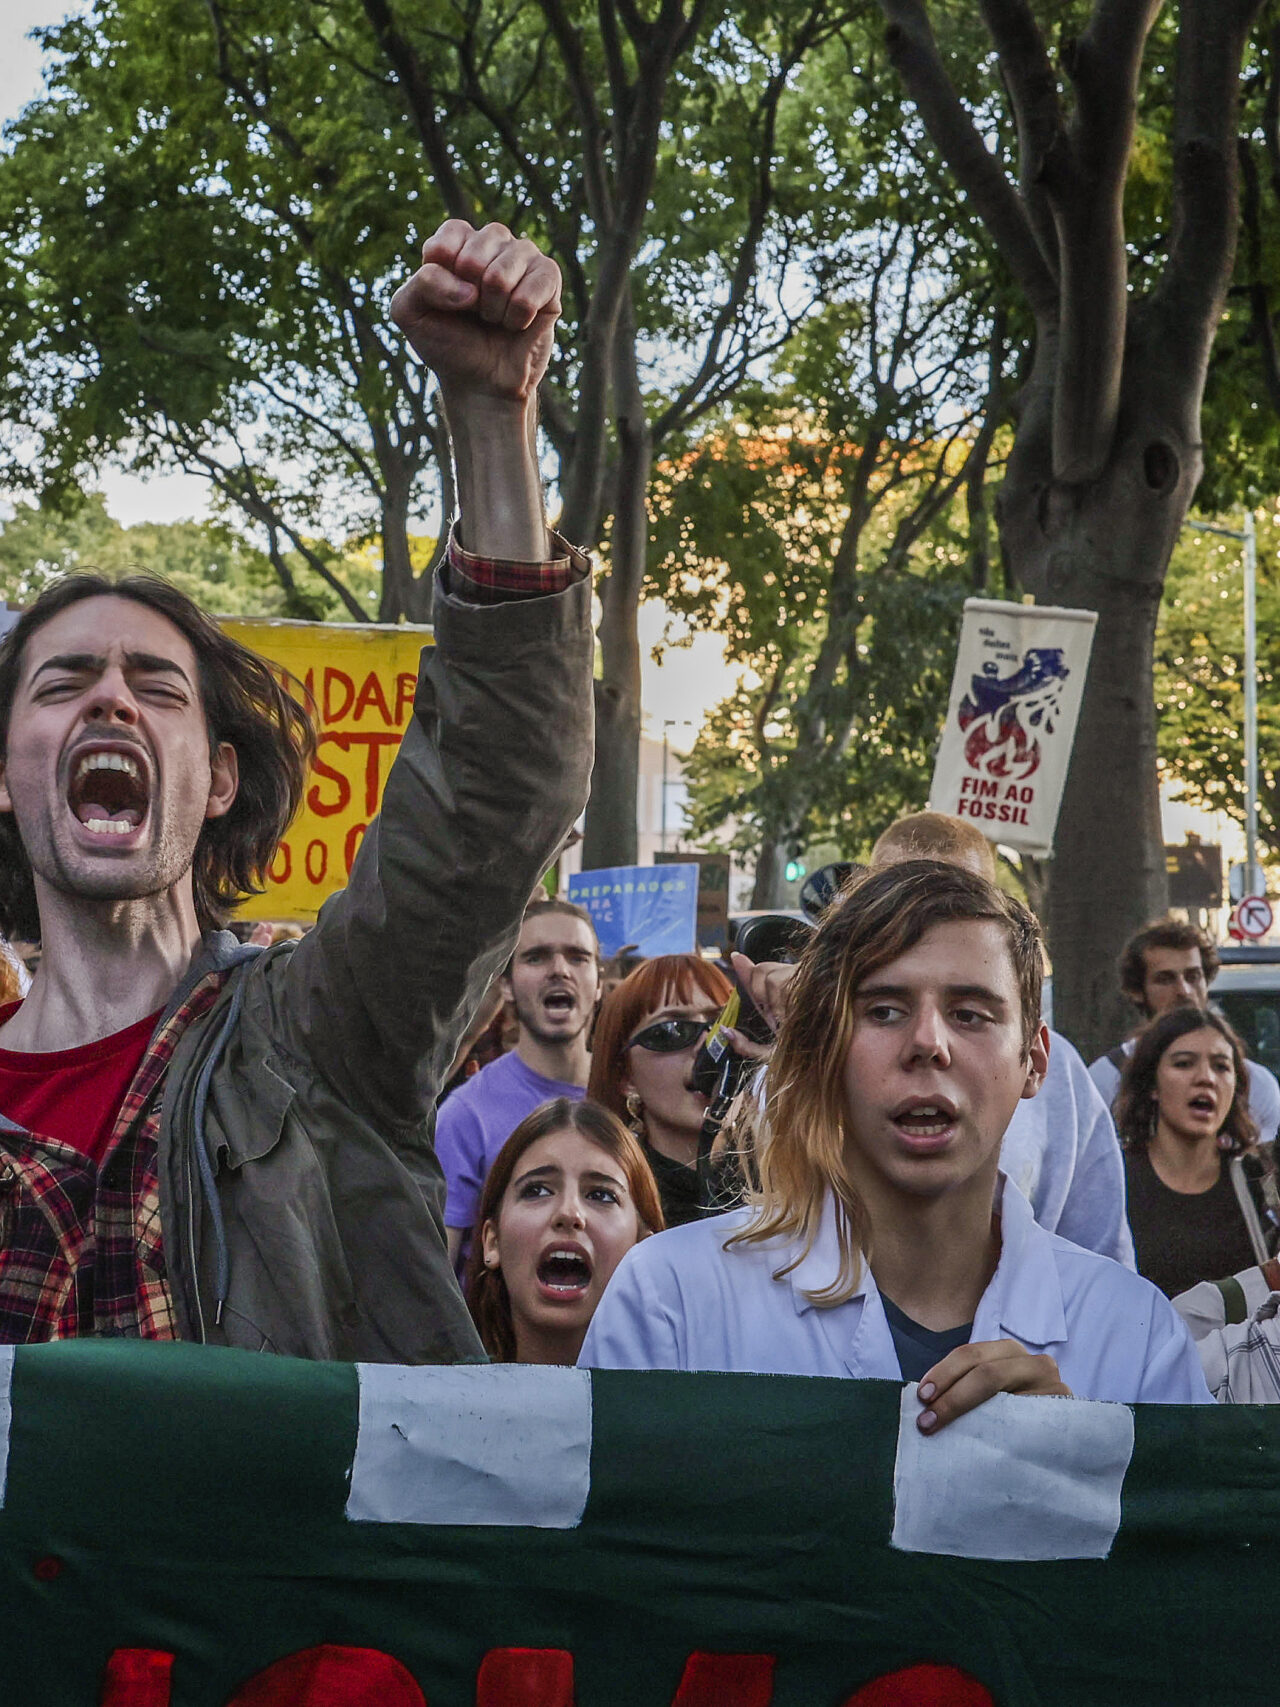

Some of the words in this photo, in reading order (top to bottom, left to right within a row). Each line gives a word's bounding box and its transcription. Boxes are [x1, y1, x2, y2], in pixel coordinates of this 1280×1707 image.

[961, 776, 999, 799] FIM
[1005, 784, 1034, 804] AO
[957, 799, 1029, 826] FOSSIL
